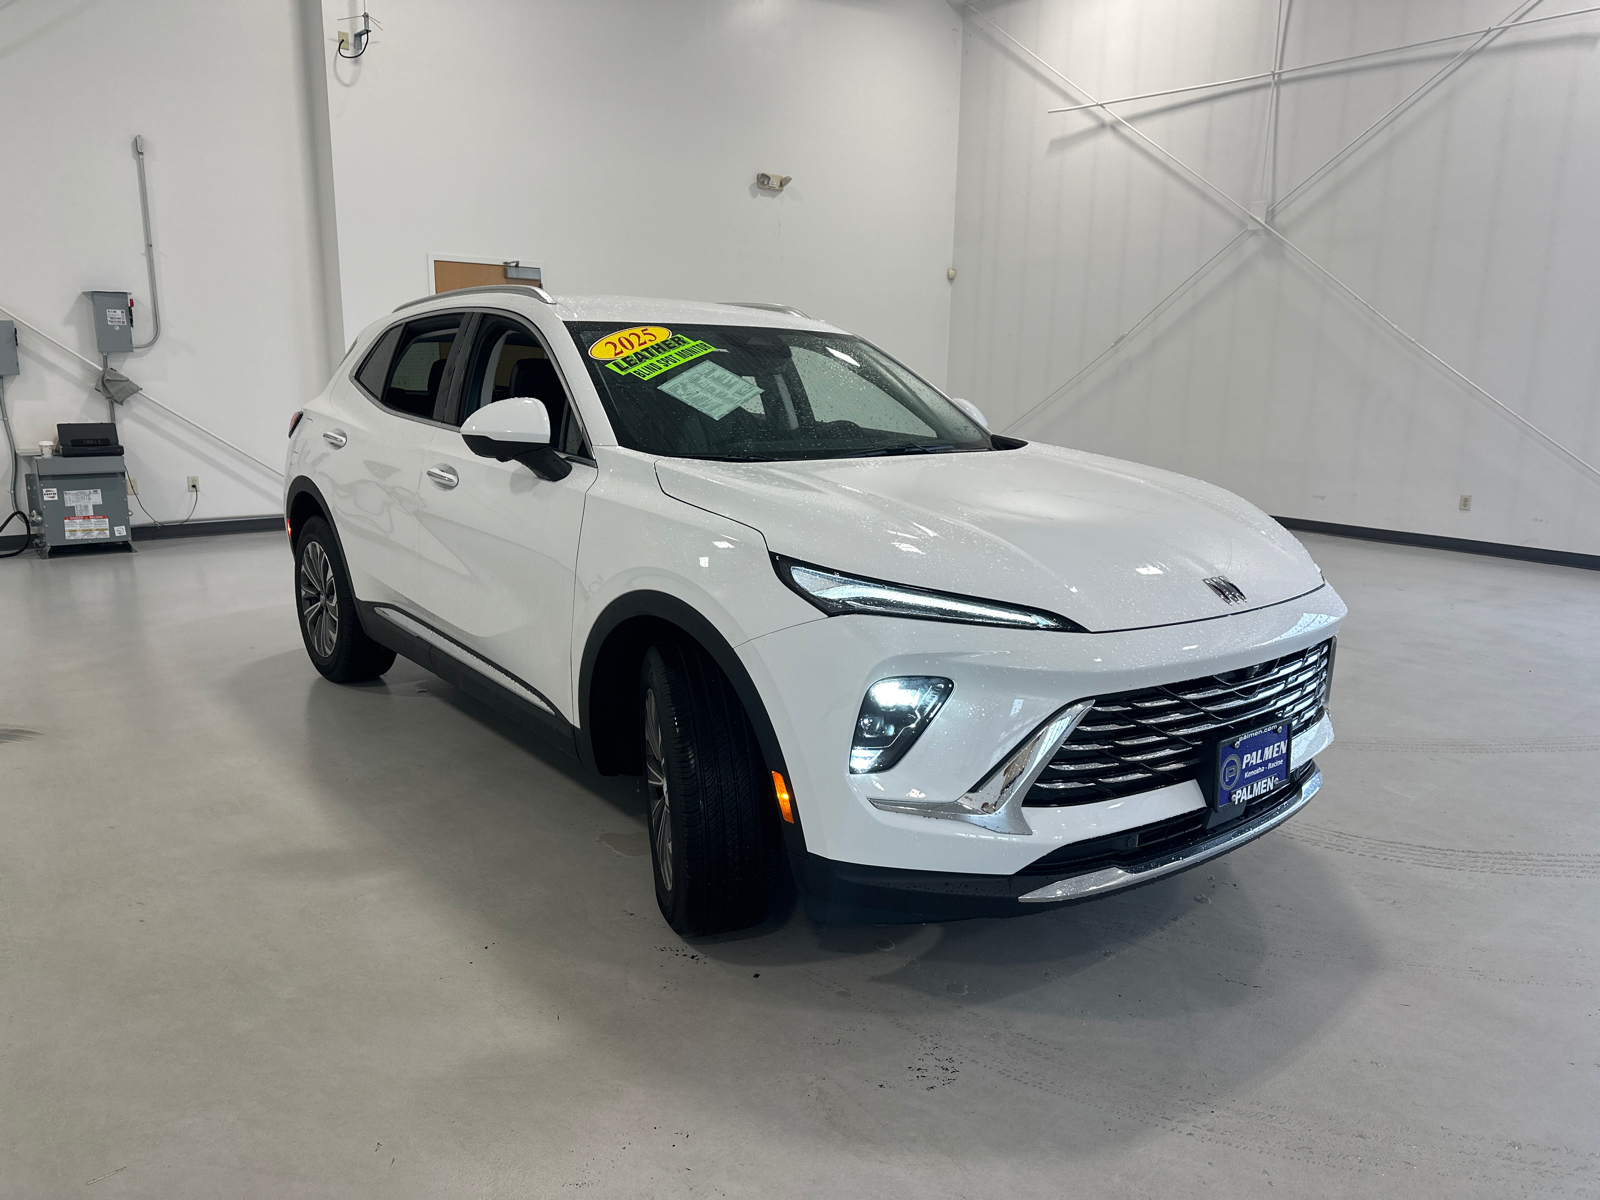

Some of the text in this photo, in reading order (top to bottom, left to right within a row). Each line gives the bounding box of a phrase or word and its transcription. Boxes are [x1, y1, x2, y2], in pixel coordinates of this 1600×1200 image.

[605, 328, 657, 356] 2025
[612, 335, 687, 372] LEATHER
[633, 342, 713, 378] BLIND SPOT MONITOR
[1242, 739, 1288, 769] PALMEN
[1244, 766, 1265, 778] Kenosha
[1268, 759, 1284, 770] Racine
[1234, 776, 1275, 805] PALMEN
